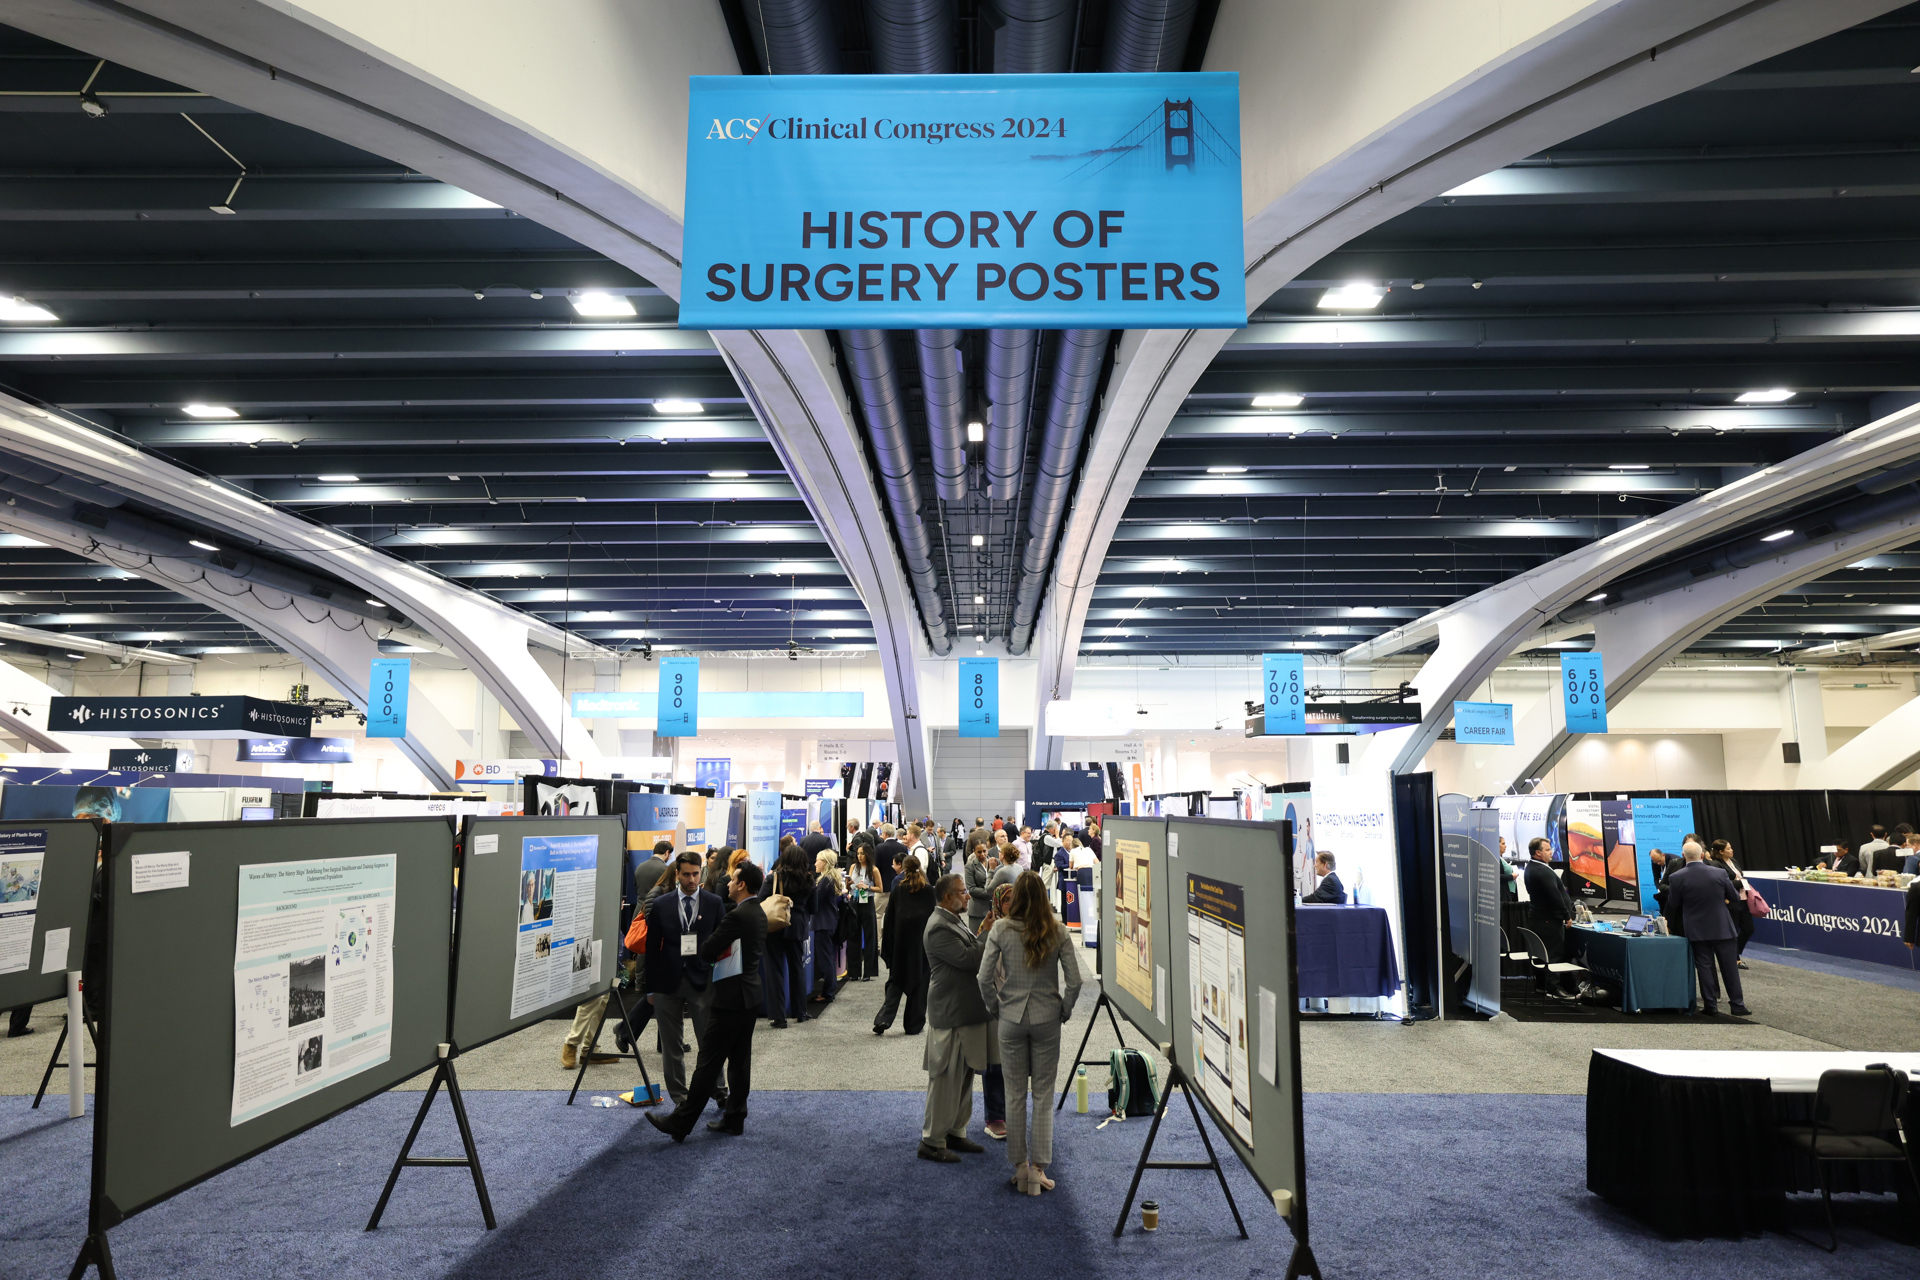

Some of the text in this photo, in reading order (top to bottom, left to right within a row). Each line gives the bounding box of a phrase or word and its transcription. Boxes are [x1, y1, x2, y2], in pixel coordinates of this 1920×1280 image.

[706, 117, 1068, 145] ACS Clinical Congress 2024
[801, 210, 1125, 249] HISTORY OF
[706, 262, 1220, 302] SURGERY POSTERS
[382, 670, 394, 716] 1000
[673, 673, 683, 708] 900
[974, 673, 983, 709] 800
[100, 707, 220, 719] HISTOSONICS
[261, 712, 306, 725] HISTOSONICS
[1464, 726, 1506, 736] CAREER FAIR
[486, 765, 500, 774] BD
[1344, 813, 1384, 826] MANAGEMENT
[1796, 908, 1860, 932] Congress
[1861, 916, 1901, 938] 2024
